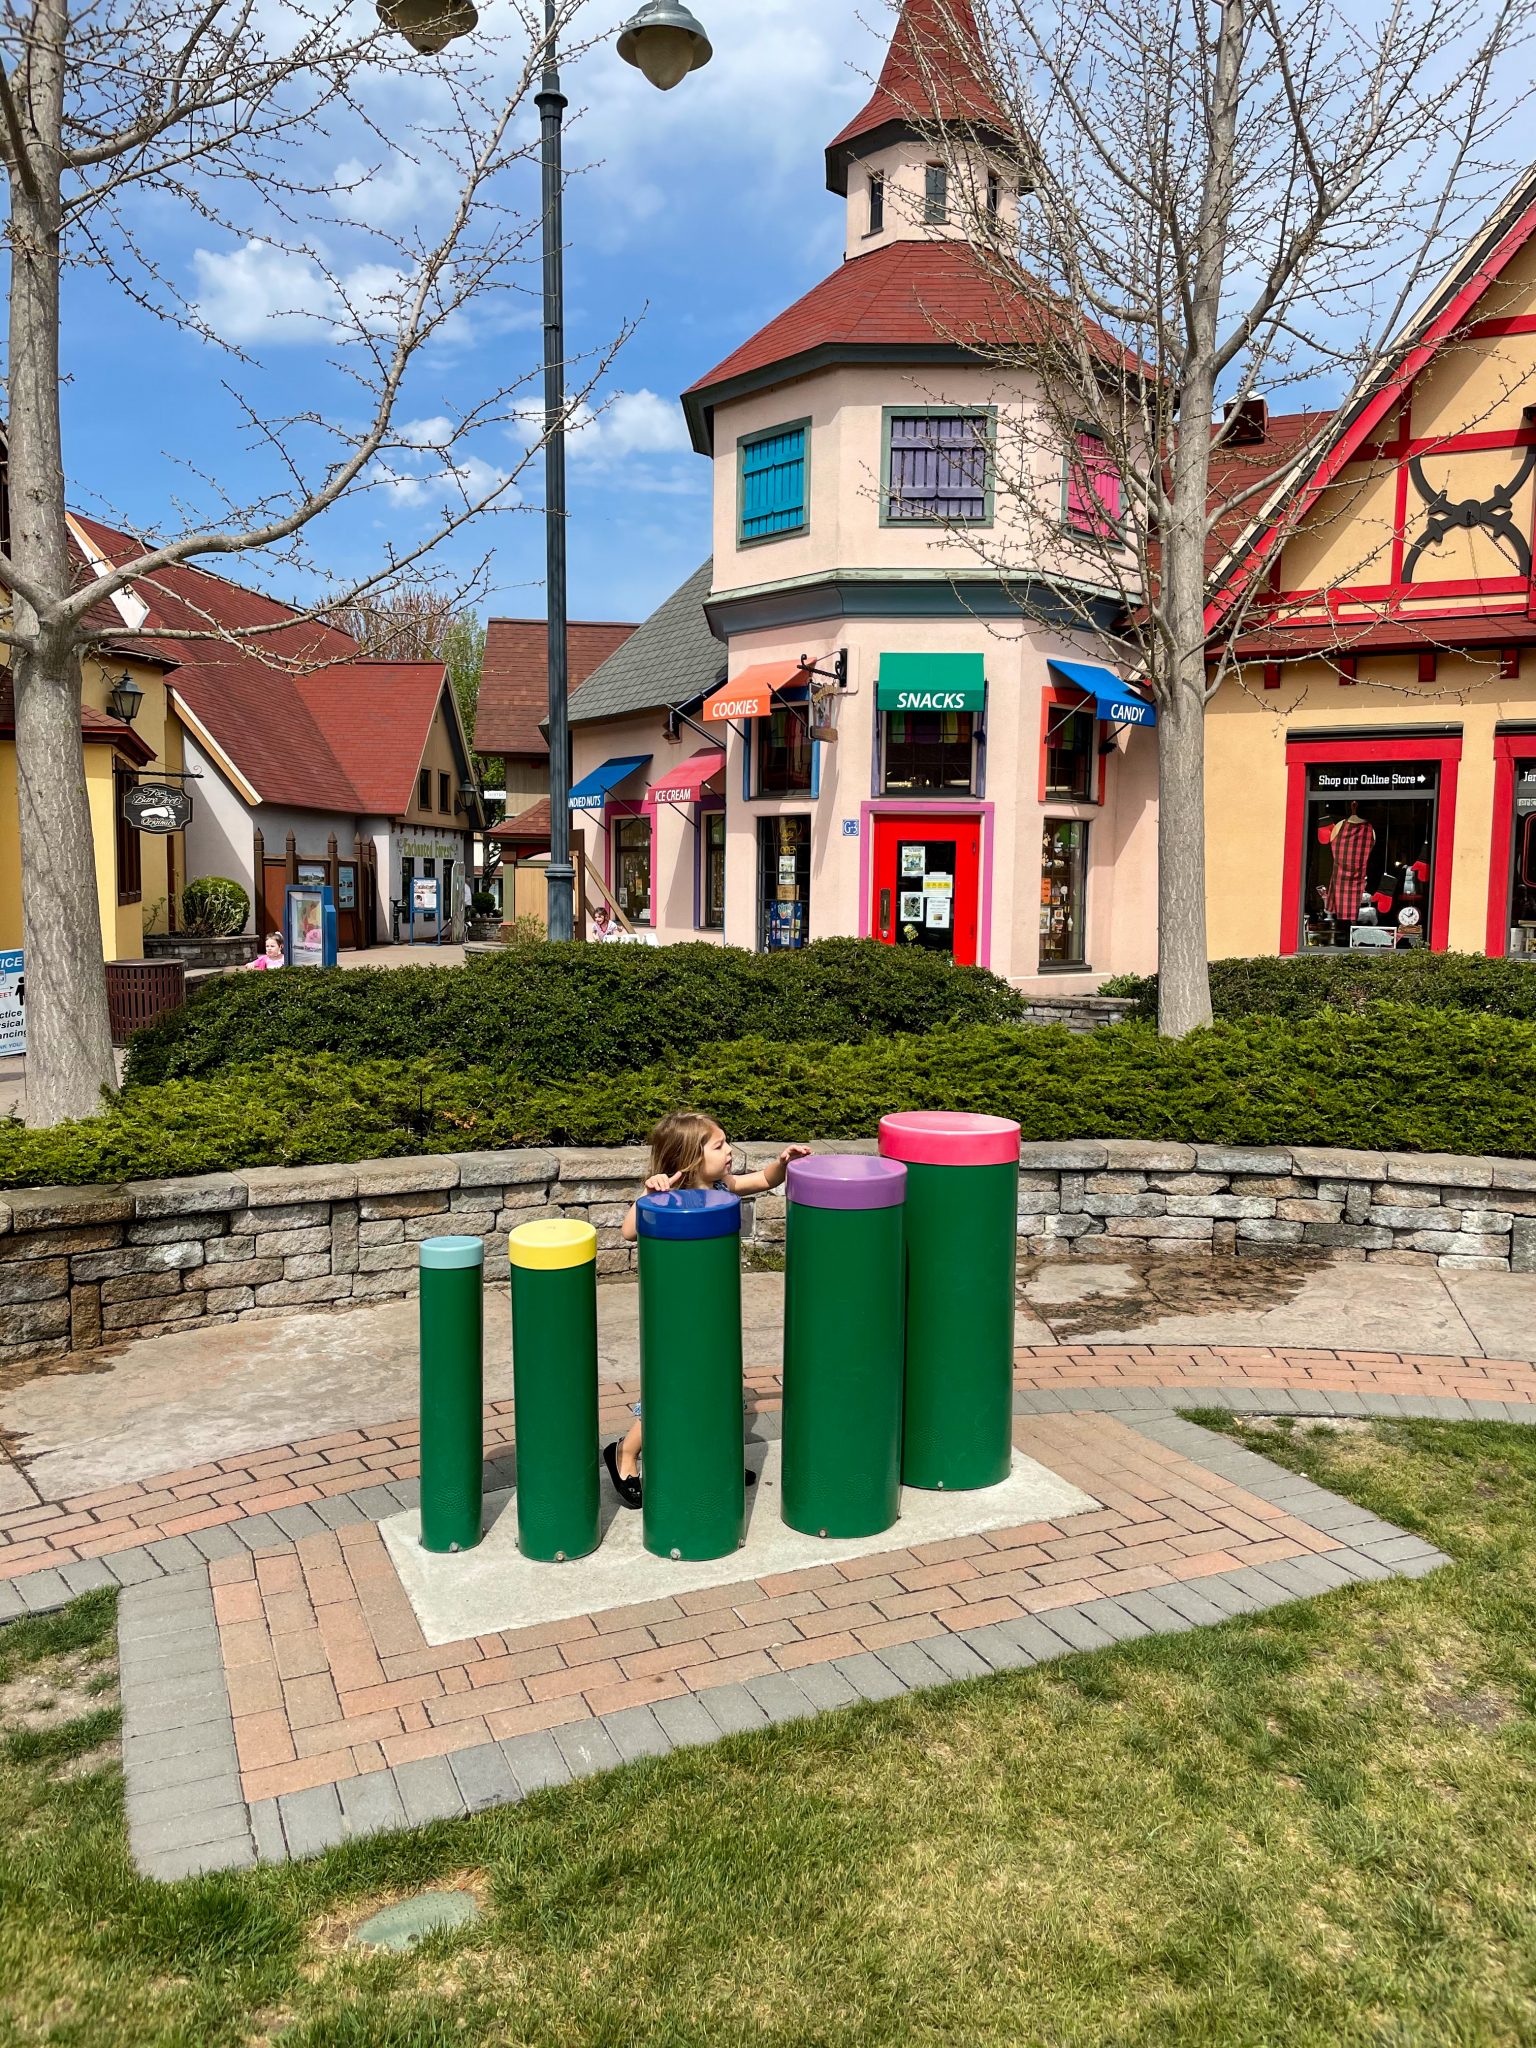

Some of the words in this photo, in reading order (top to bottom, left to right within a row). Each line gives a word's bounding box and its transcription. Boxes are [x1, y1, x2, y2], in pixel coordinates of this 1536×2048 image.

[897, 692, 965, 708] SNACKS
[712, 699, 758, 717] COOKIES
[1110, 703, 1145, 722] CANDY
[1318, 774, 1341, 787] Shop
[1343, 777, 1358, 785] our
[1360, 774, 1389, 784] Online
[1391, 773, 1415, 784] Store
[586, 795, 601, 807] NUTS
[655, 789, 666, 801] ICE
[667, 788, 691, 801] CREAM
[403, 837, 432, 857] Enchanted
[435, 840, 453, 858] Forest
[0, 956, 23, 969] ICE
[0, 1018, 24, 1029] sical
